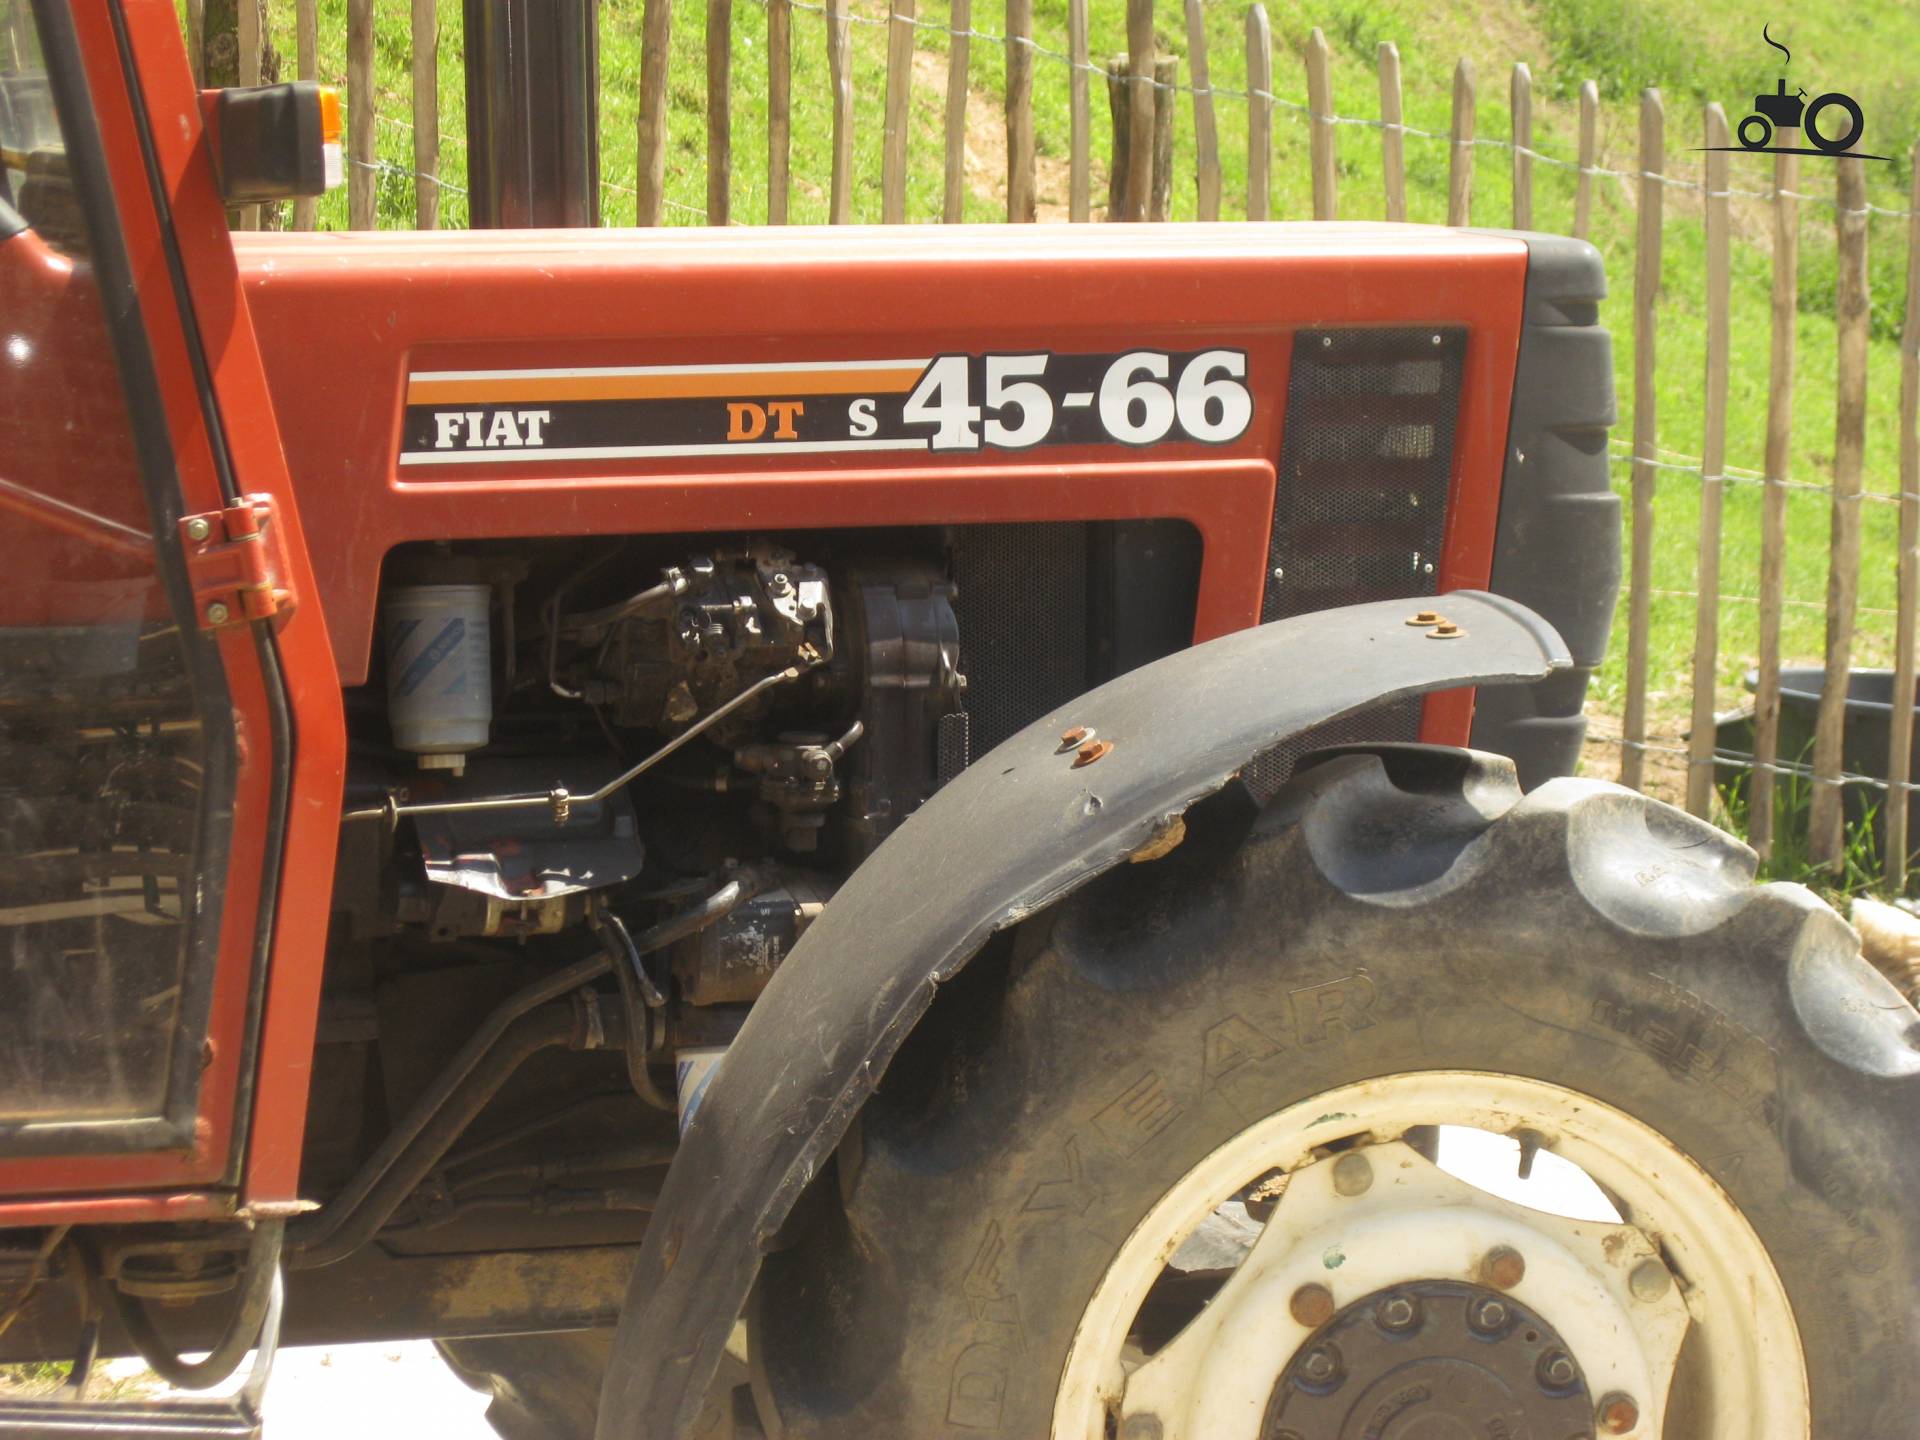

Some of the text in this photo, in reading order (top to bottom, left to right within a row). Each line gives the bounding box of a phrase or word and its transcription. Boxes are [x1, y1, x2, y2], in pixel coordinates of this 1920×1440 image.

[434, 350, 1252, 450] FIAT DT S 45-66
